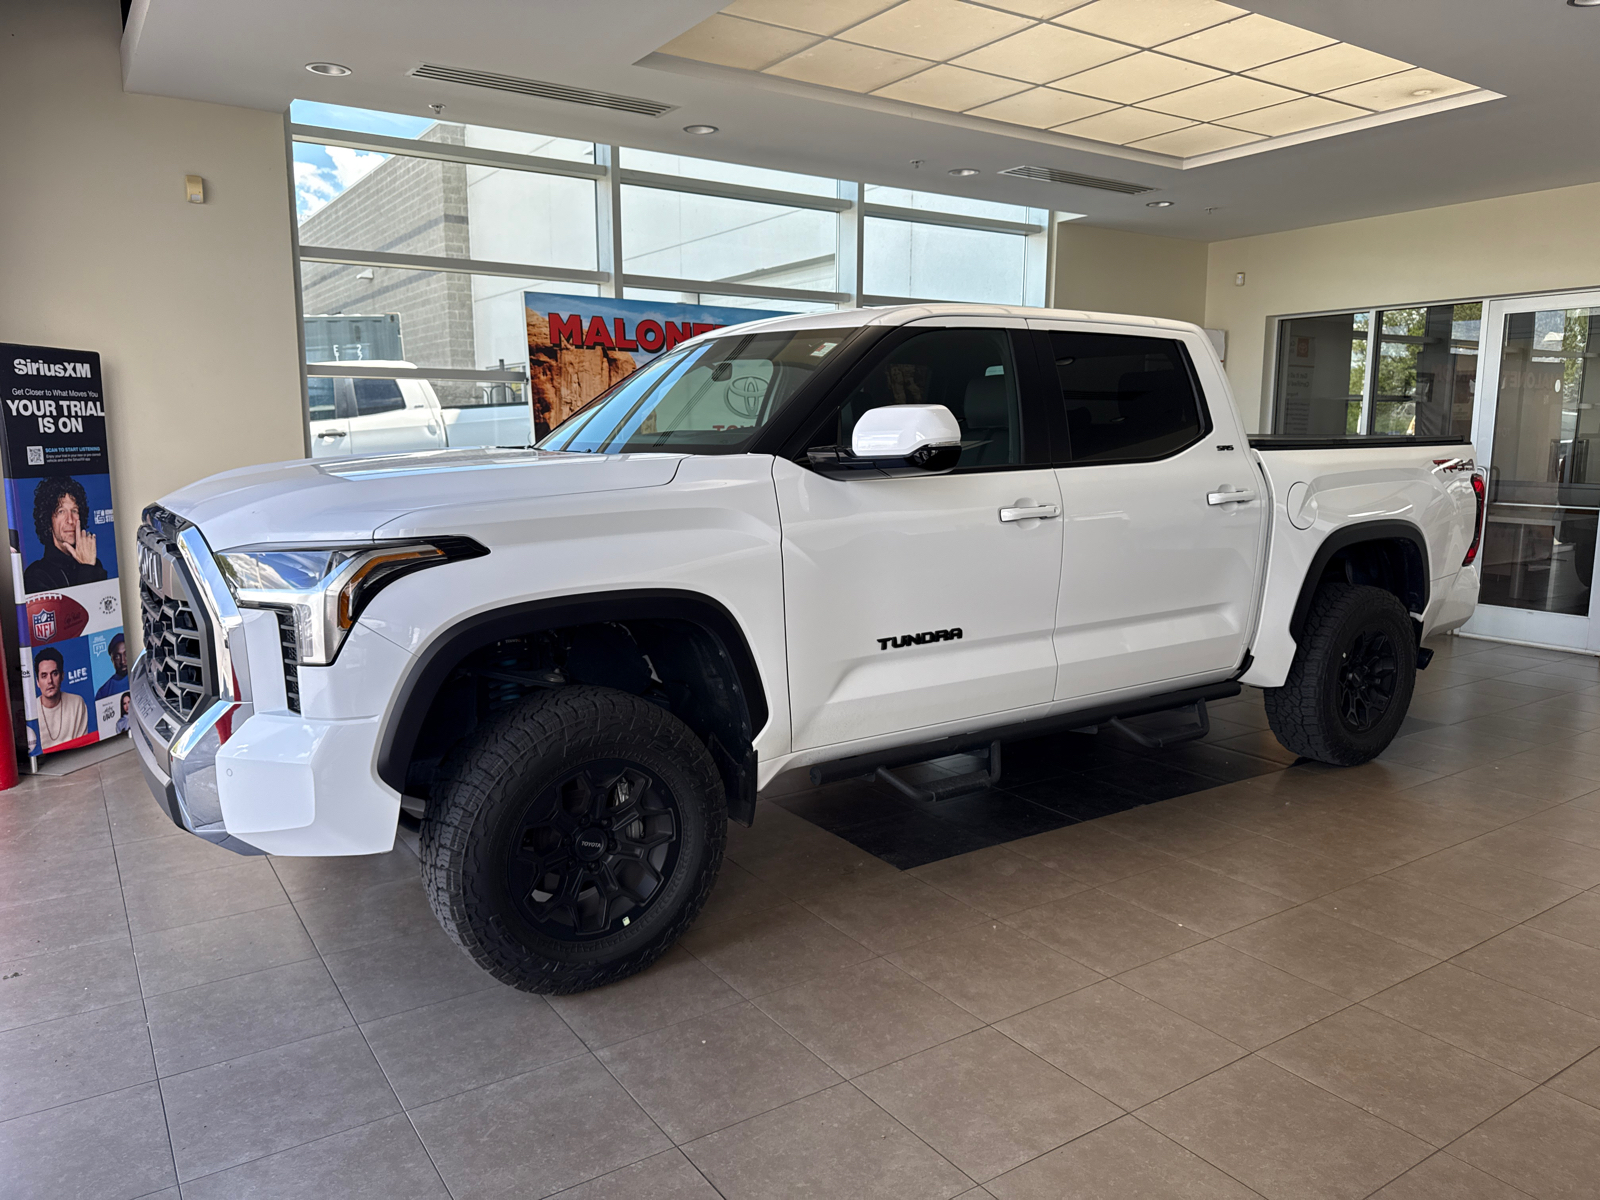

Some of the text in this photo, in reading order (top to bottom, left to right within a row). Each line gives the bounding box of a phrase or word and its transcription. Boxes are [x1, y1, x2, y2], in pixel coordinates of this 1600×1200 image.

[13, 358, 92, 378] SiriusXM
[12, 388, 24, 396] Get
[25, 388, 44, 396] Closer
[52, 389, 68, 397] What
[69, 390, 87, 398] Moves
[6, 399, 106, 417] YOUR TRIAL
[38, 417, 83, 433] IS ON
[35, 622, 55, 641] NFL
[876, 627, 963, 651] TUNDRA
[68, 667, 87, 680] LIFE
[581, 840, 601, 849] TOYOTA
